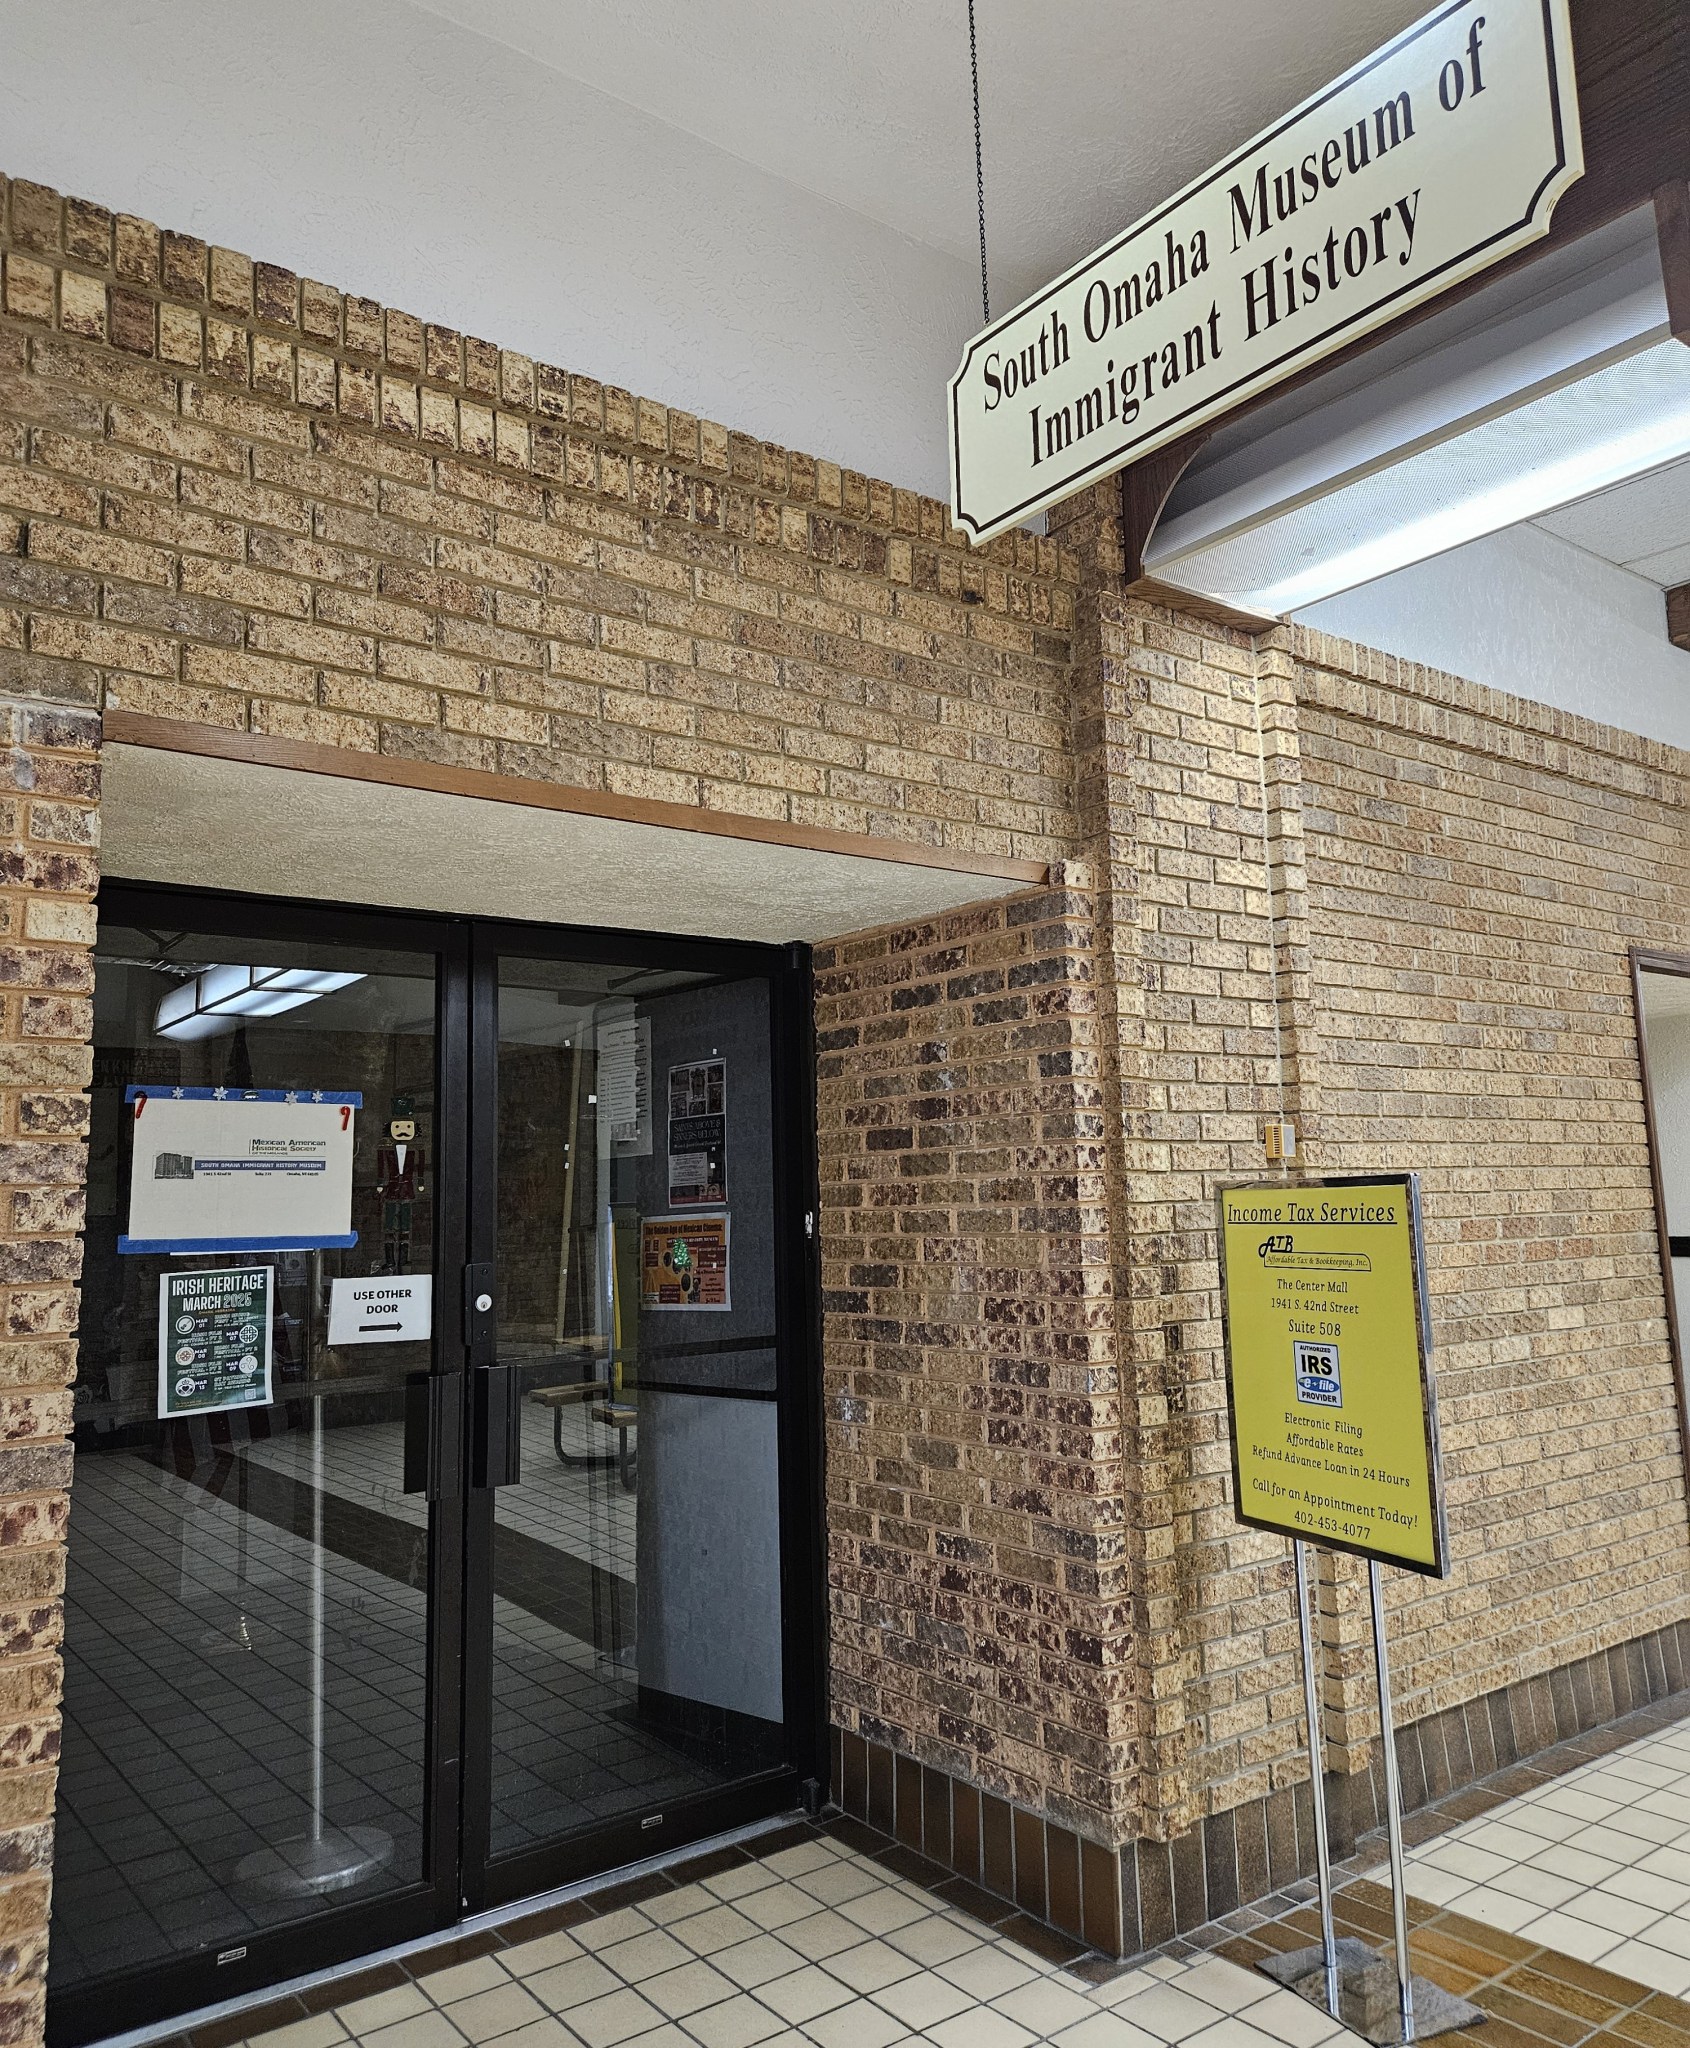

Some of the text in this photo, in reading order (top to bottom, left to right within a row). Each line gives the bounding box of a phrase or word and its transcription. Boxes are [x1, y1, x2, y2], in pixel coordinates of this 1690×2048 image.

[983, 15, 1488, 412] South Omaha Museum of
[1029, 188, 1422, 468] Immigrant History
[1228, 1202, 1395, 1222] Income Tax Services
[1258, 1235, 1293, 1257] ATB
[1266, 1256, 1295, 1265] Affordable
[1355, 1258, 1368, 1266] Inc.
[172, 1274, 264, 1296] IRISH HERITAGE
[353, 1289, 412, 1300] USE OTHER
[1277, 1278, 1348, 1293] The Center Mall
[183, 1295, 221, 1311] MARCH
[366, 1304, 398, 1314] DOOR
[1271, 1298, 1359, 1314] 1941 S. 42nd Street
[1289, 1319, 1341, 1336] Suite 508
[1300, 1345, 1331, 1353] AUTHORIZED
[1301, 1354, 1332, 1375] IRS
[1302, 1391, 1337, 1403] PROVIDER
[1285, 1412, 1363, 1439] Electronic Filing
[1287, 1433, 1364, 1456] Affordable Rates
[1252, 1445, 1410, 1487] Refund Advance Loan in 24 Hours
[1252, 1478, 1418, 1530] Call for an Appointment Today!
[1294, 1510, 1371, 1540] 402-453-4077
